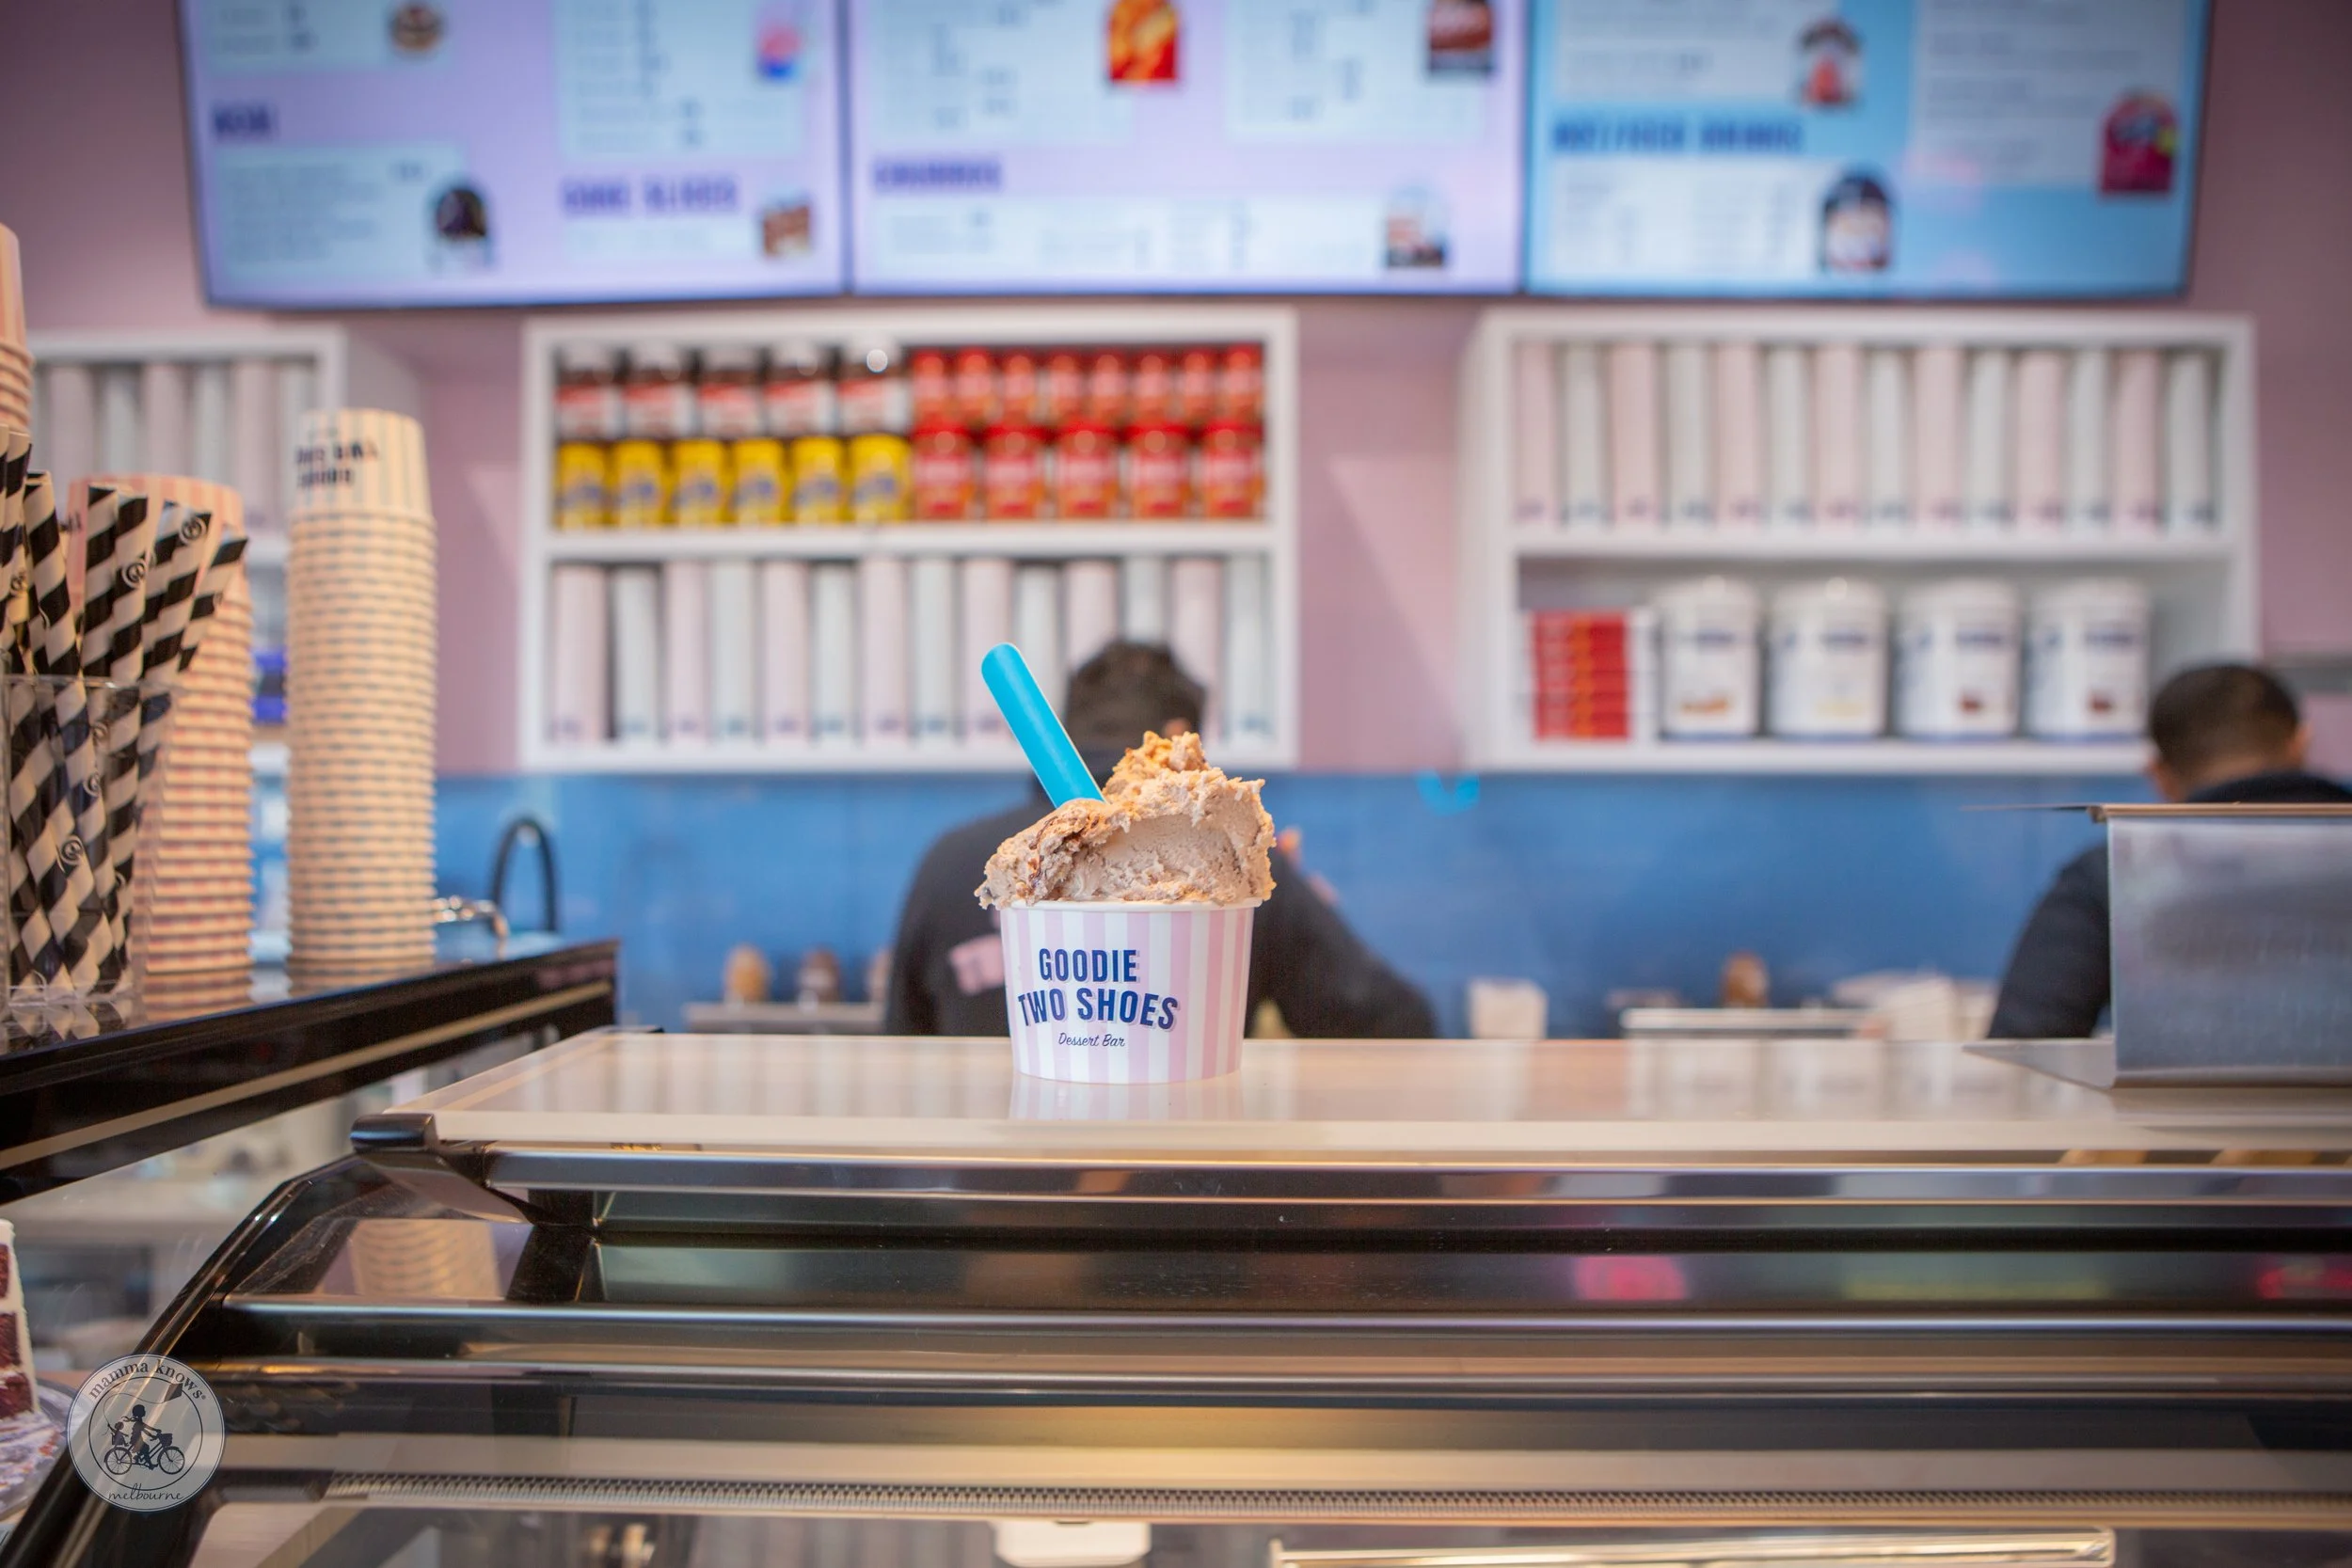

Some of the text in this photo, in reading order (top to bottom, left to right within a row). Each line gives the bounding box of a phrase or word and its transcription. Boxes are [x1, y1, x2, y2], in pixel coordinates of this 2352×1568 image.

[1039, 948, 1138, 983] GOODIE
[1018, 988, 1180, 1031] TWO SHOES
[1058, 1033, 1125, 1048] Dessert Bar
